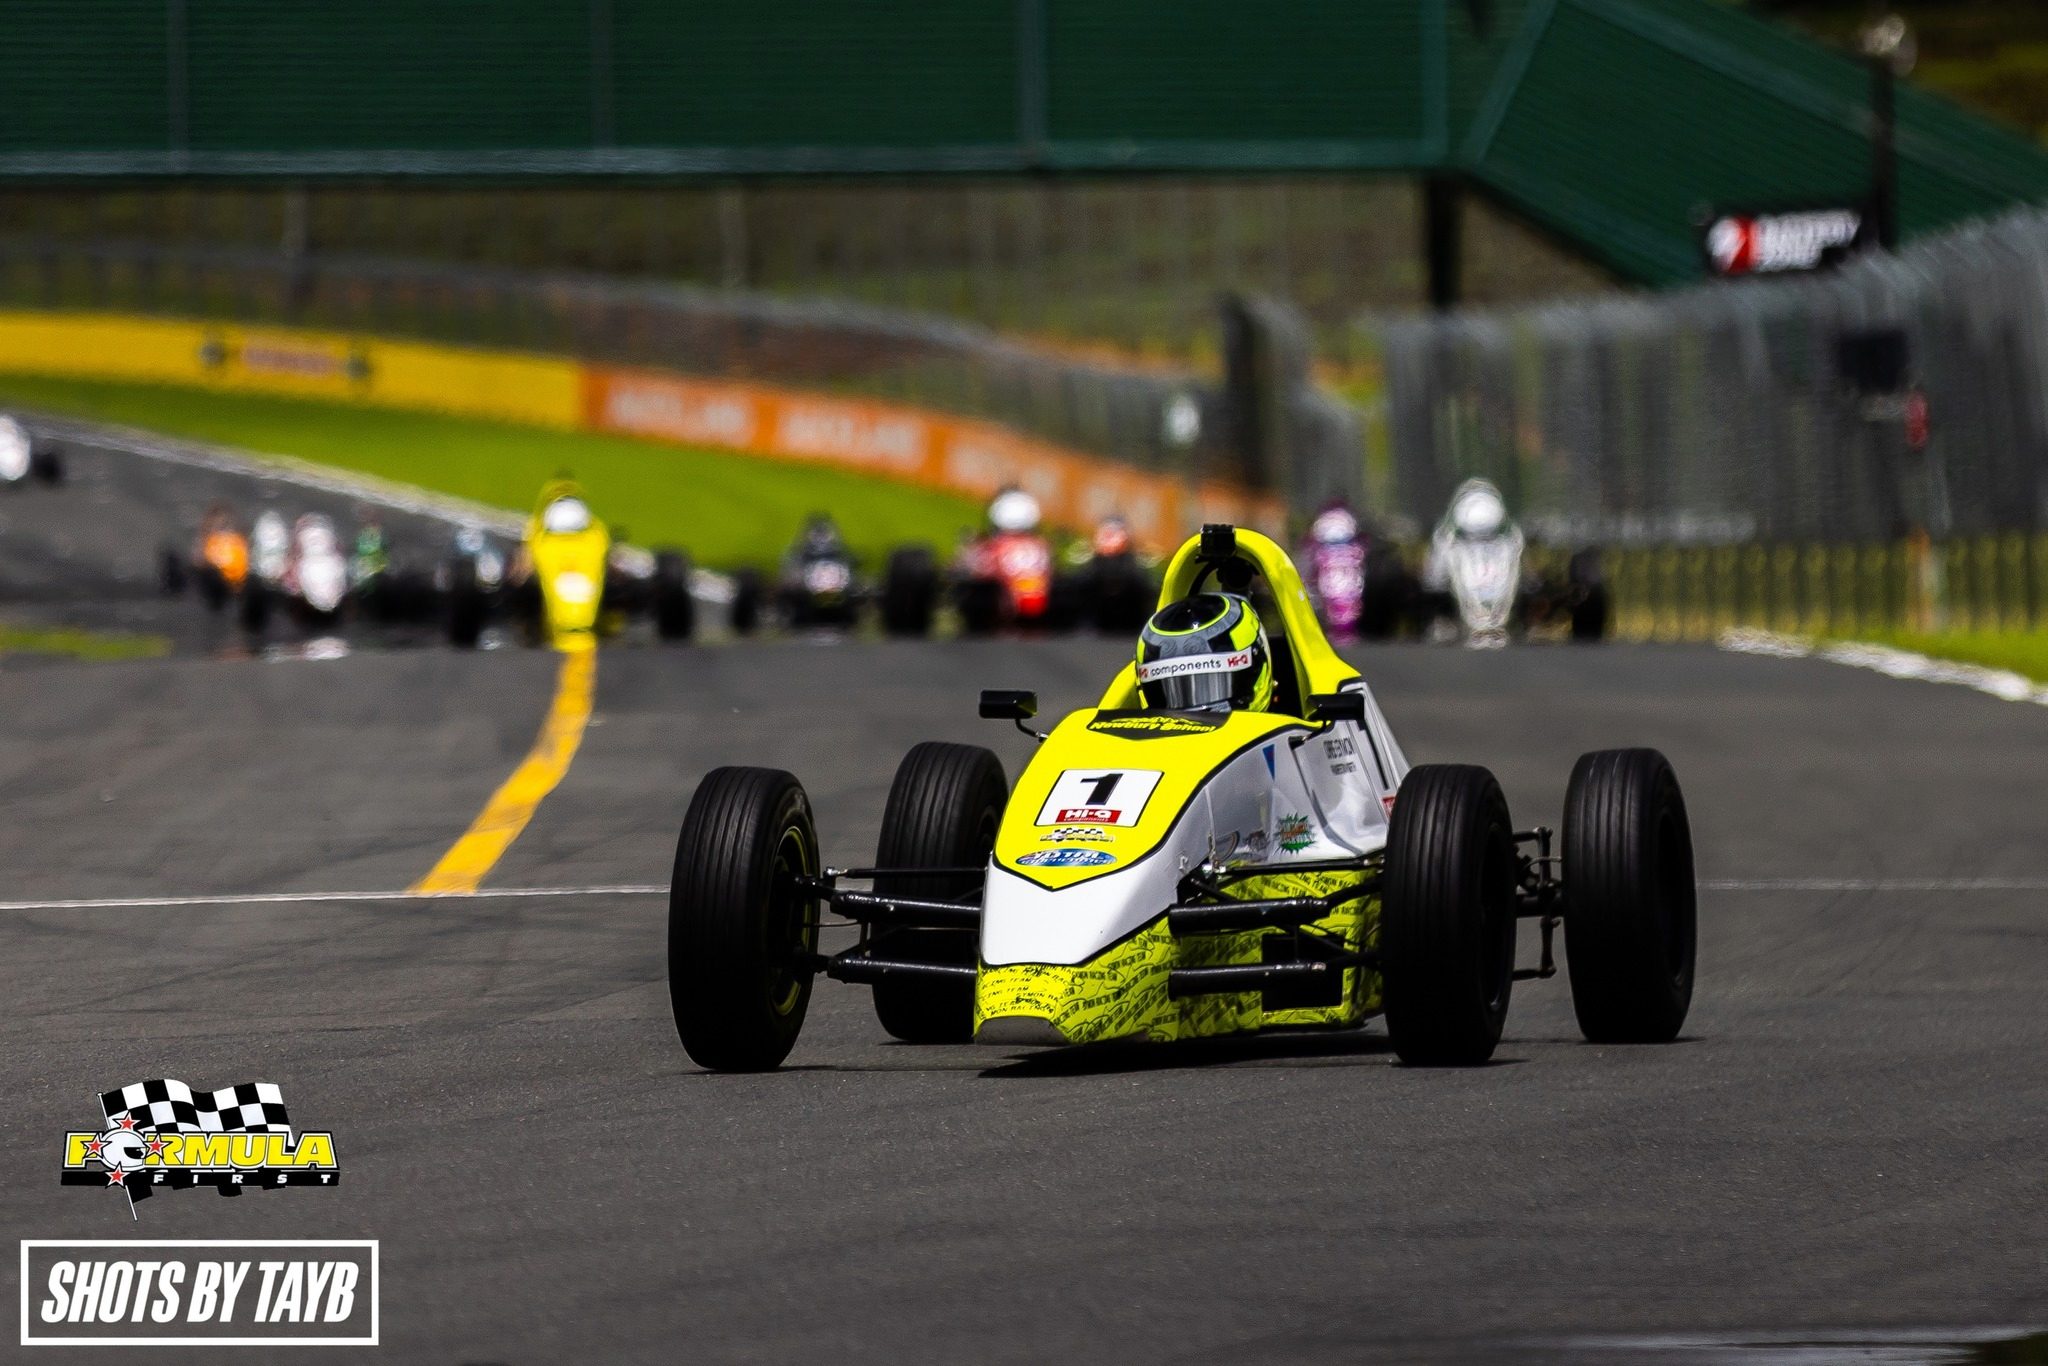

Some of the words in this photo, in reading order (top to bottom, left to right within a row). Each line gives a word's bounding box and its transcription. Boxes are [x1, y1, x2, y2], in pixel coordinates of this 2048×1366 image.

[1150, 658, 1222, 675] components
[1089, 721, 1160, 731] Newbury
[1080, 772, 1124, 806] 1
